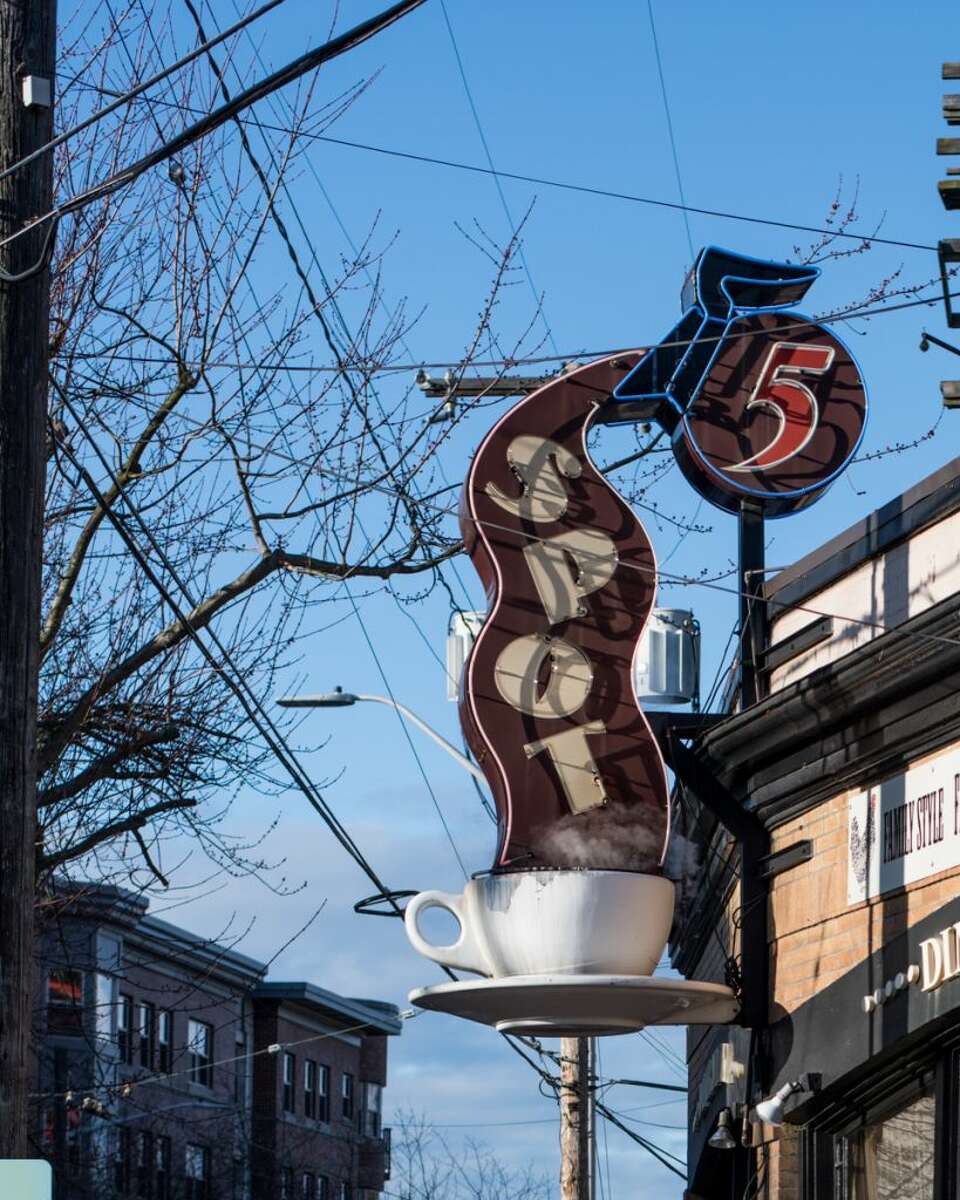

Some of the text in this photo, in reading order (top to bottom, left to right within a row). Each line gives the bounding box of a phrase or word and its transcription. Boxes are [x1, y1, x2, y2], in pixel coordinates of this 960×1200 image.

[721, 341, 835, 472] 5
[485, 435, 619, 817] SPOT
[883, 799, 915, 864] FAMILY
[916, 787, 944, 851] STYLE
